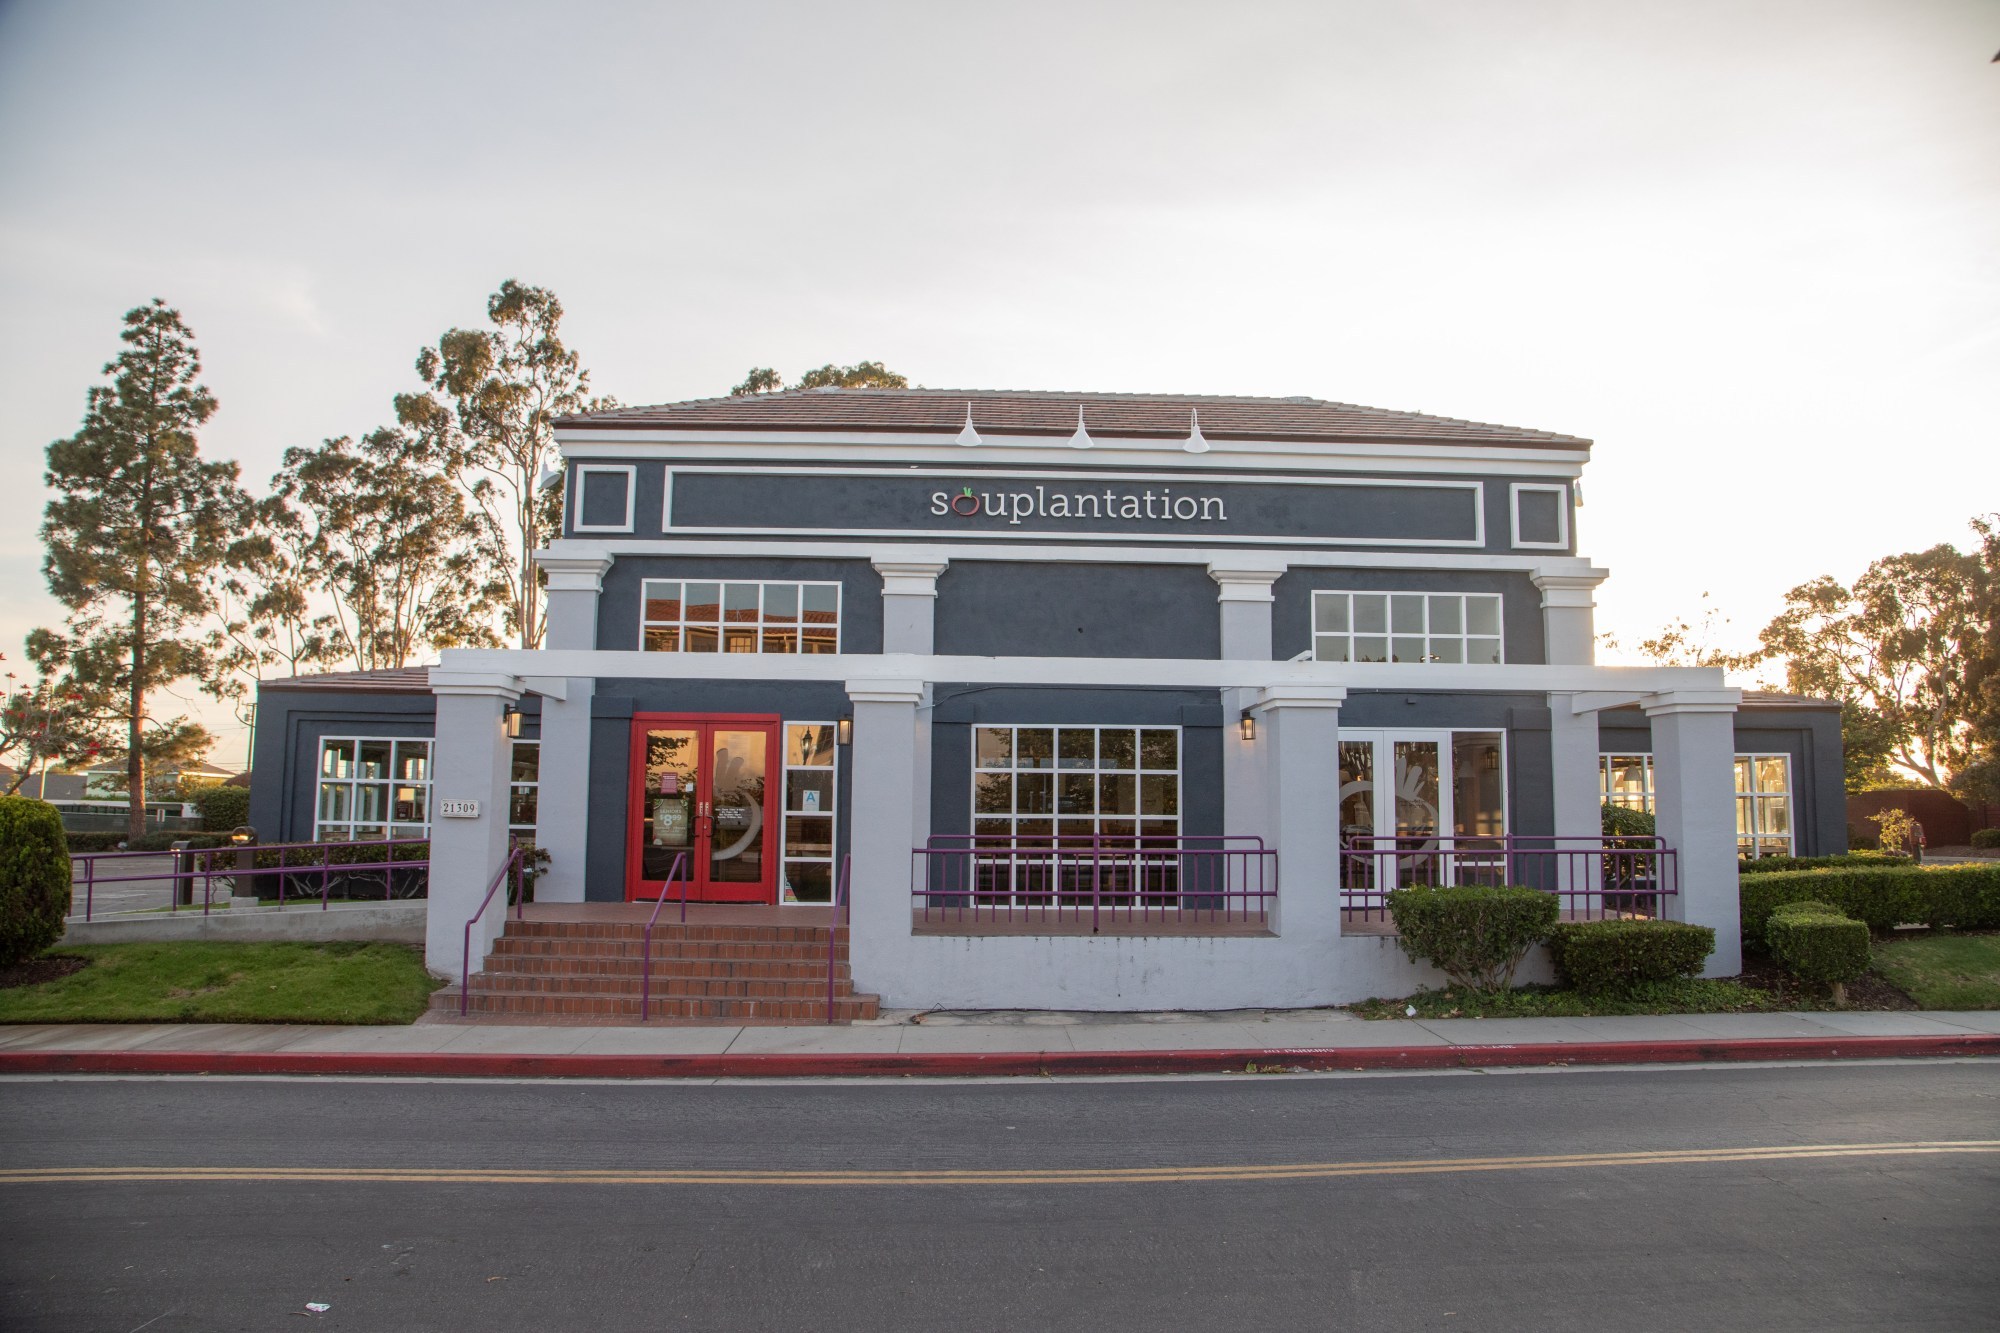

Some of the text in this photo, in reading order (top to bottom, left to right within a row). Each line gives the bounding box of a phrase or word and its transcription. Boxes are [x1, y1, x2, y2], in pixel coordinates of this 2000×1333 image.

[930, 486, 1228, 525] souplantation
[806, 791, 815, 802] A
[443, 802, 475, 813] 21309
